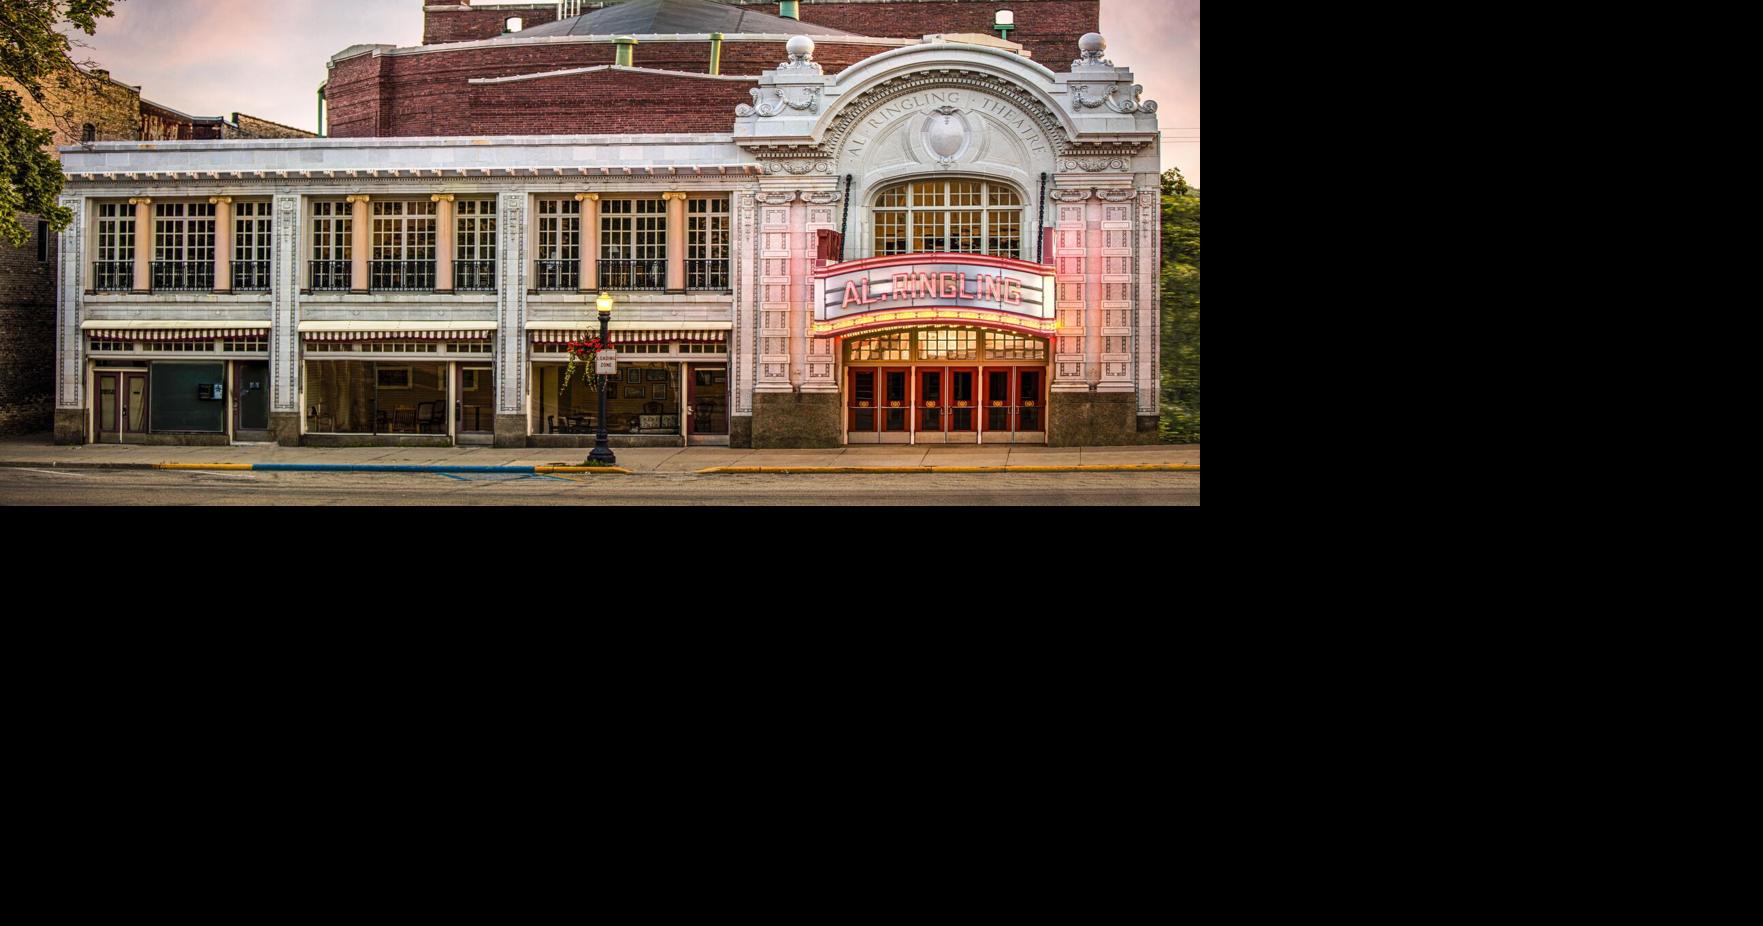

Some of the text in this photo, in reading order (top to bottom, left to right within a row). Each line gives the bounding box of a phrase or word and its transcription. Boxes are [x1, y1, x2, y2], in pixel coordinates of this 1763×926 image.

[848, 91, 1047, 157] AL RINGLING THEATRE
